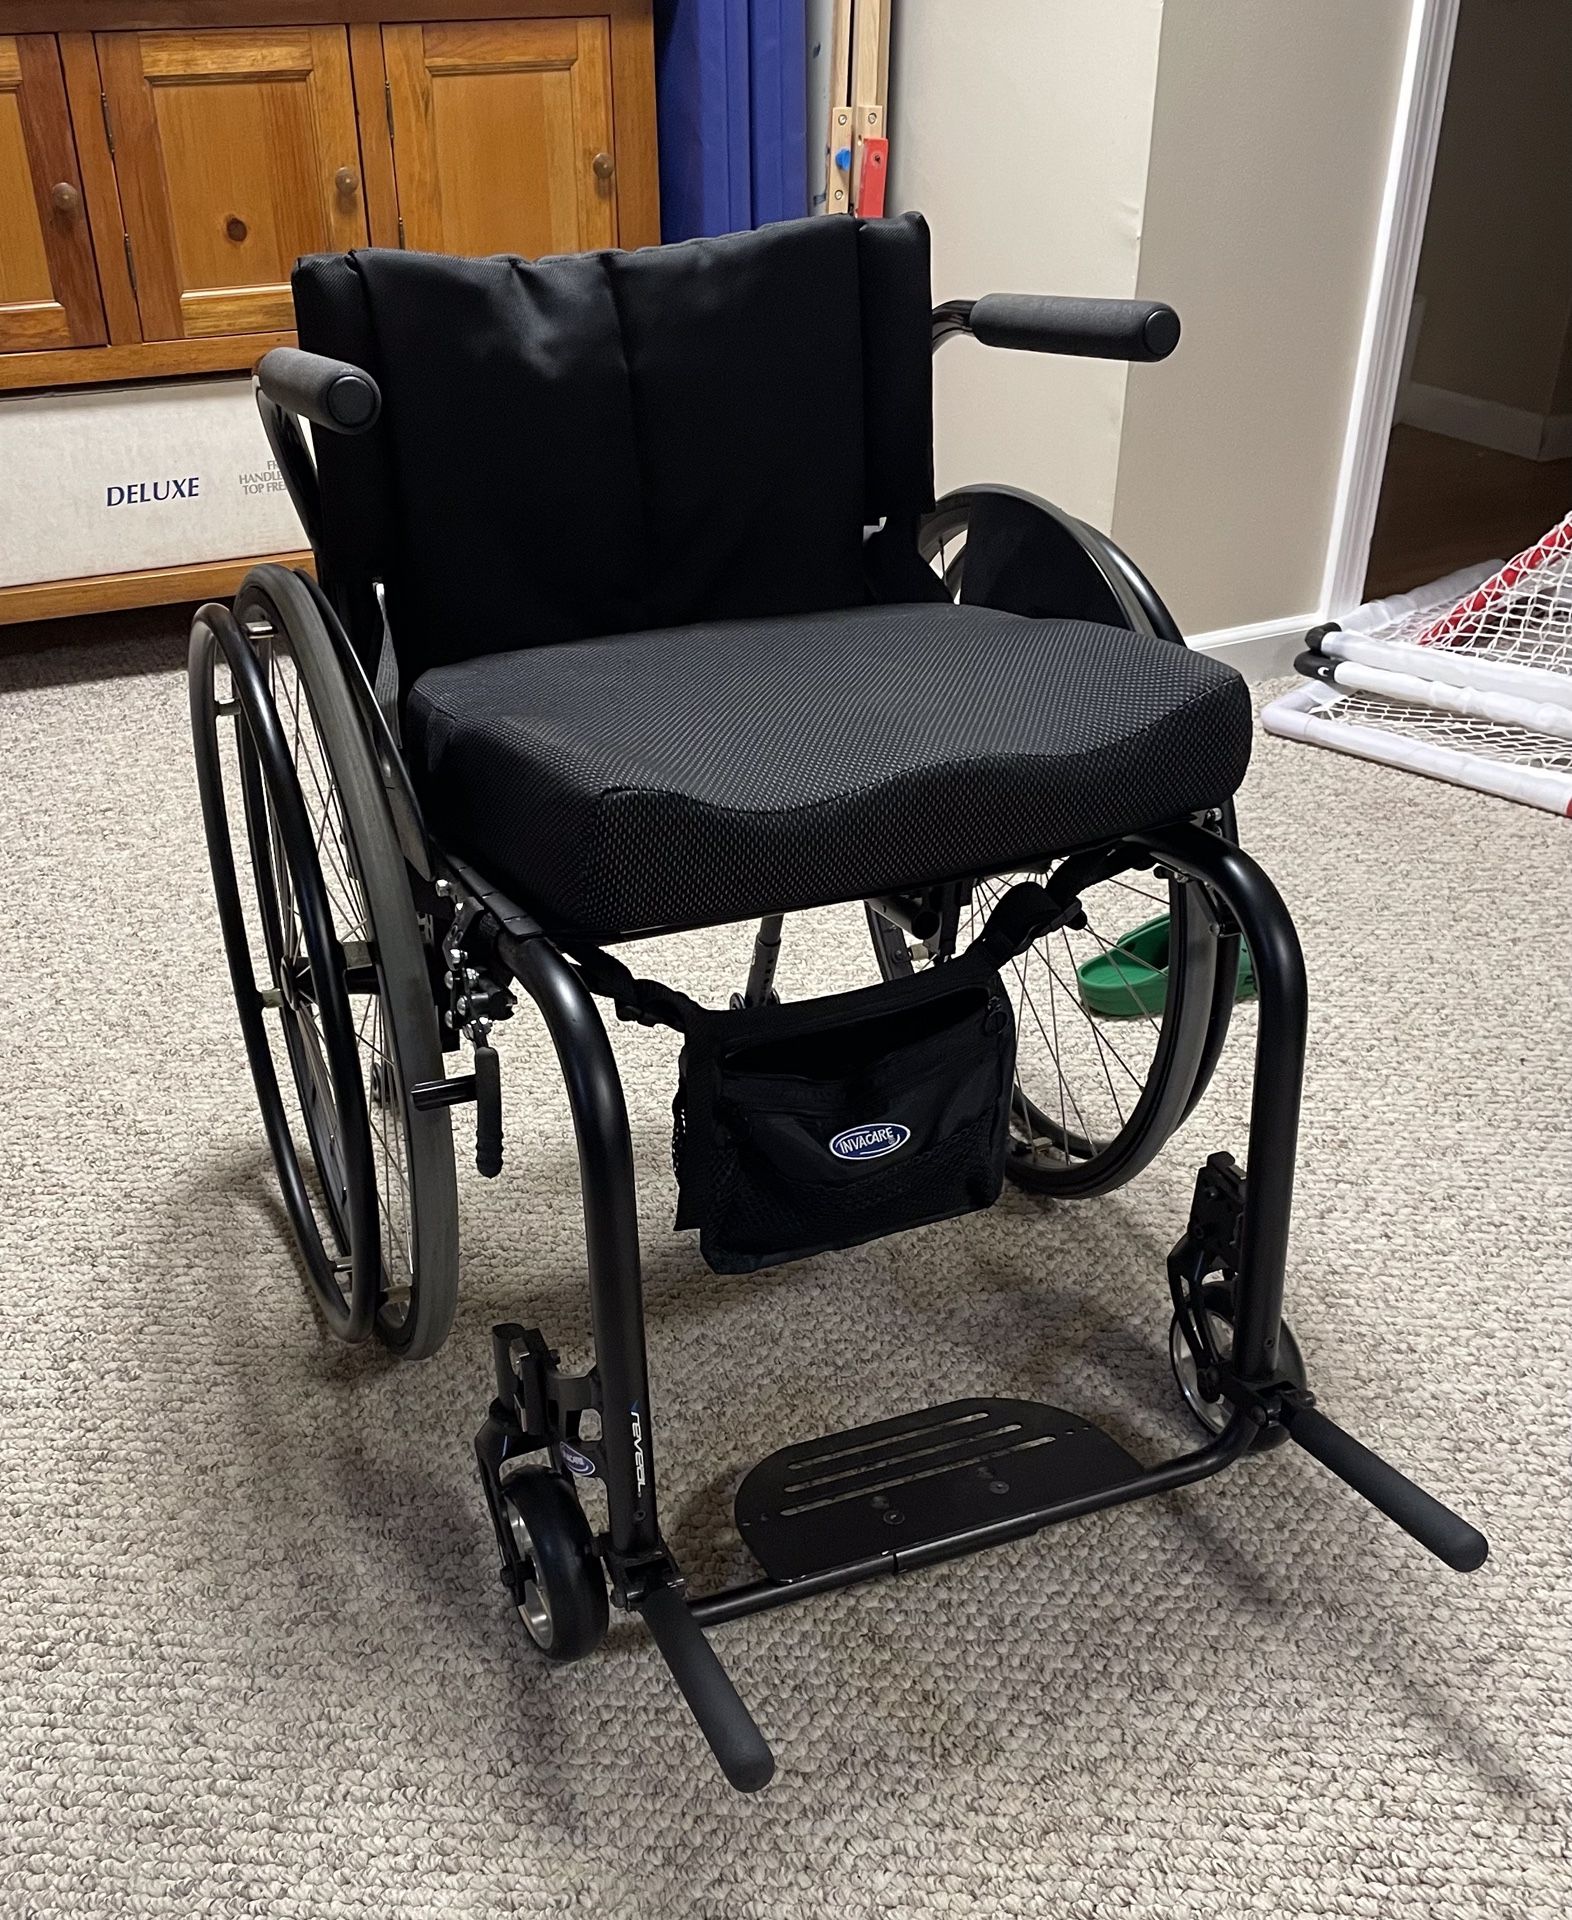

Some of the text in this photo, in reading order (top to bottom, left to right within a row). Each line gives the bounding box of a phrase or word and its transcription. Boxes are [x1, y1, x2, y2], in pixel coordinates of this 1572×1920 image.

[106, 477, 200, 507] DELUXE
[242, 484, 265, 496] TOP
[839, 1127, 894, 1154] INVACARE
